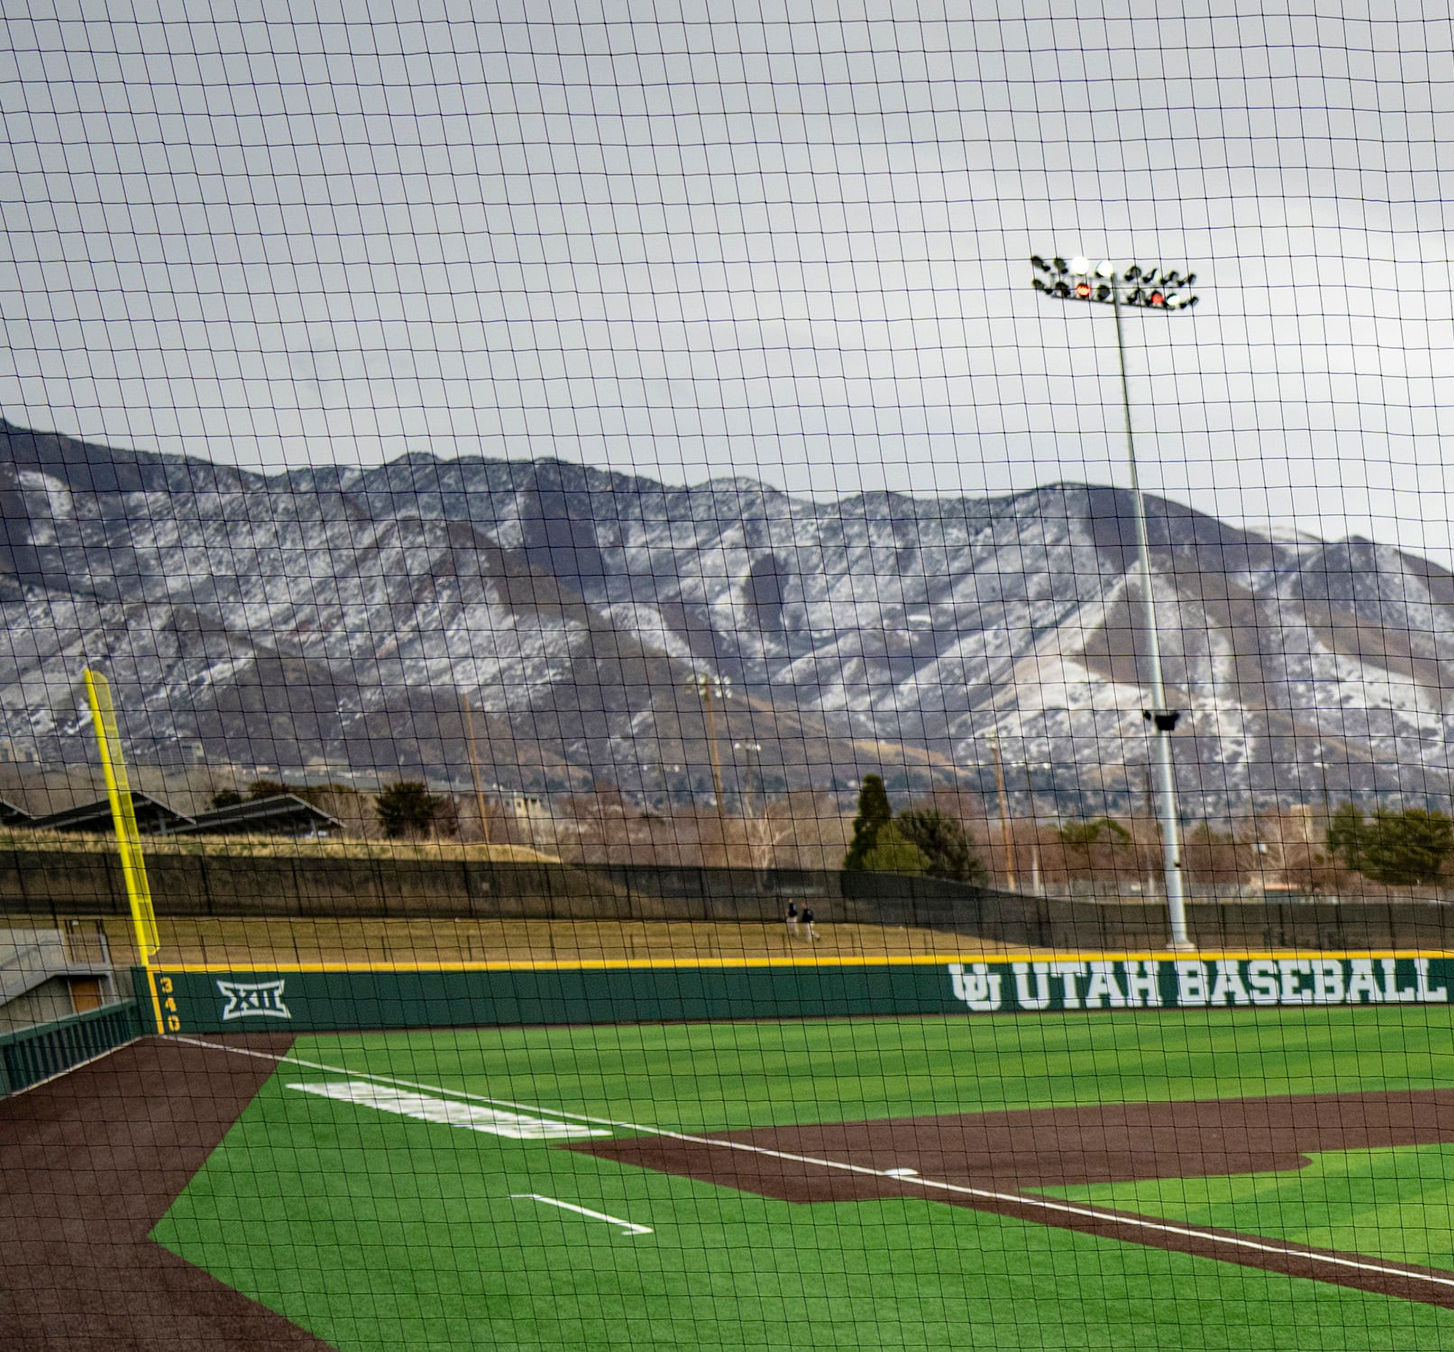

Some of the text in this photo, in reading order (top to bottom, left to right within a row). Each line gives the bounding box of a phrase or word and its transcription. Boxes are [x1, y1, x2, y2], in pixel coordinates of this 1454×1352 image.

[159, 976, 181, 1032] 340
[1011, 960, 1163, 1010] UTAH
[1173, 958, 1448, 1007] BASEBALL
